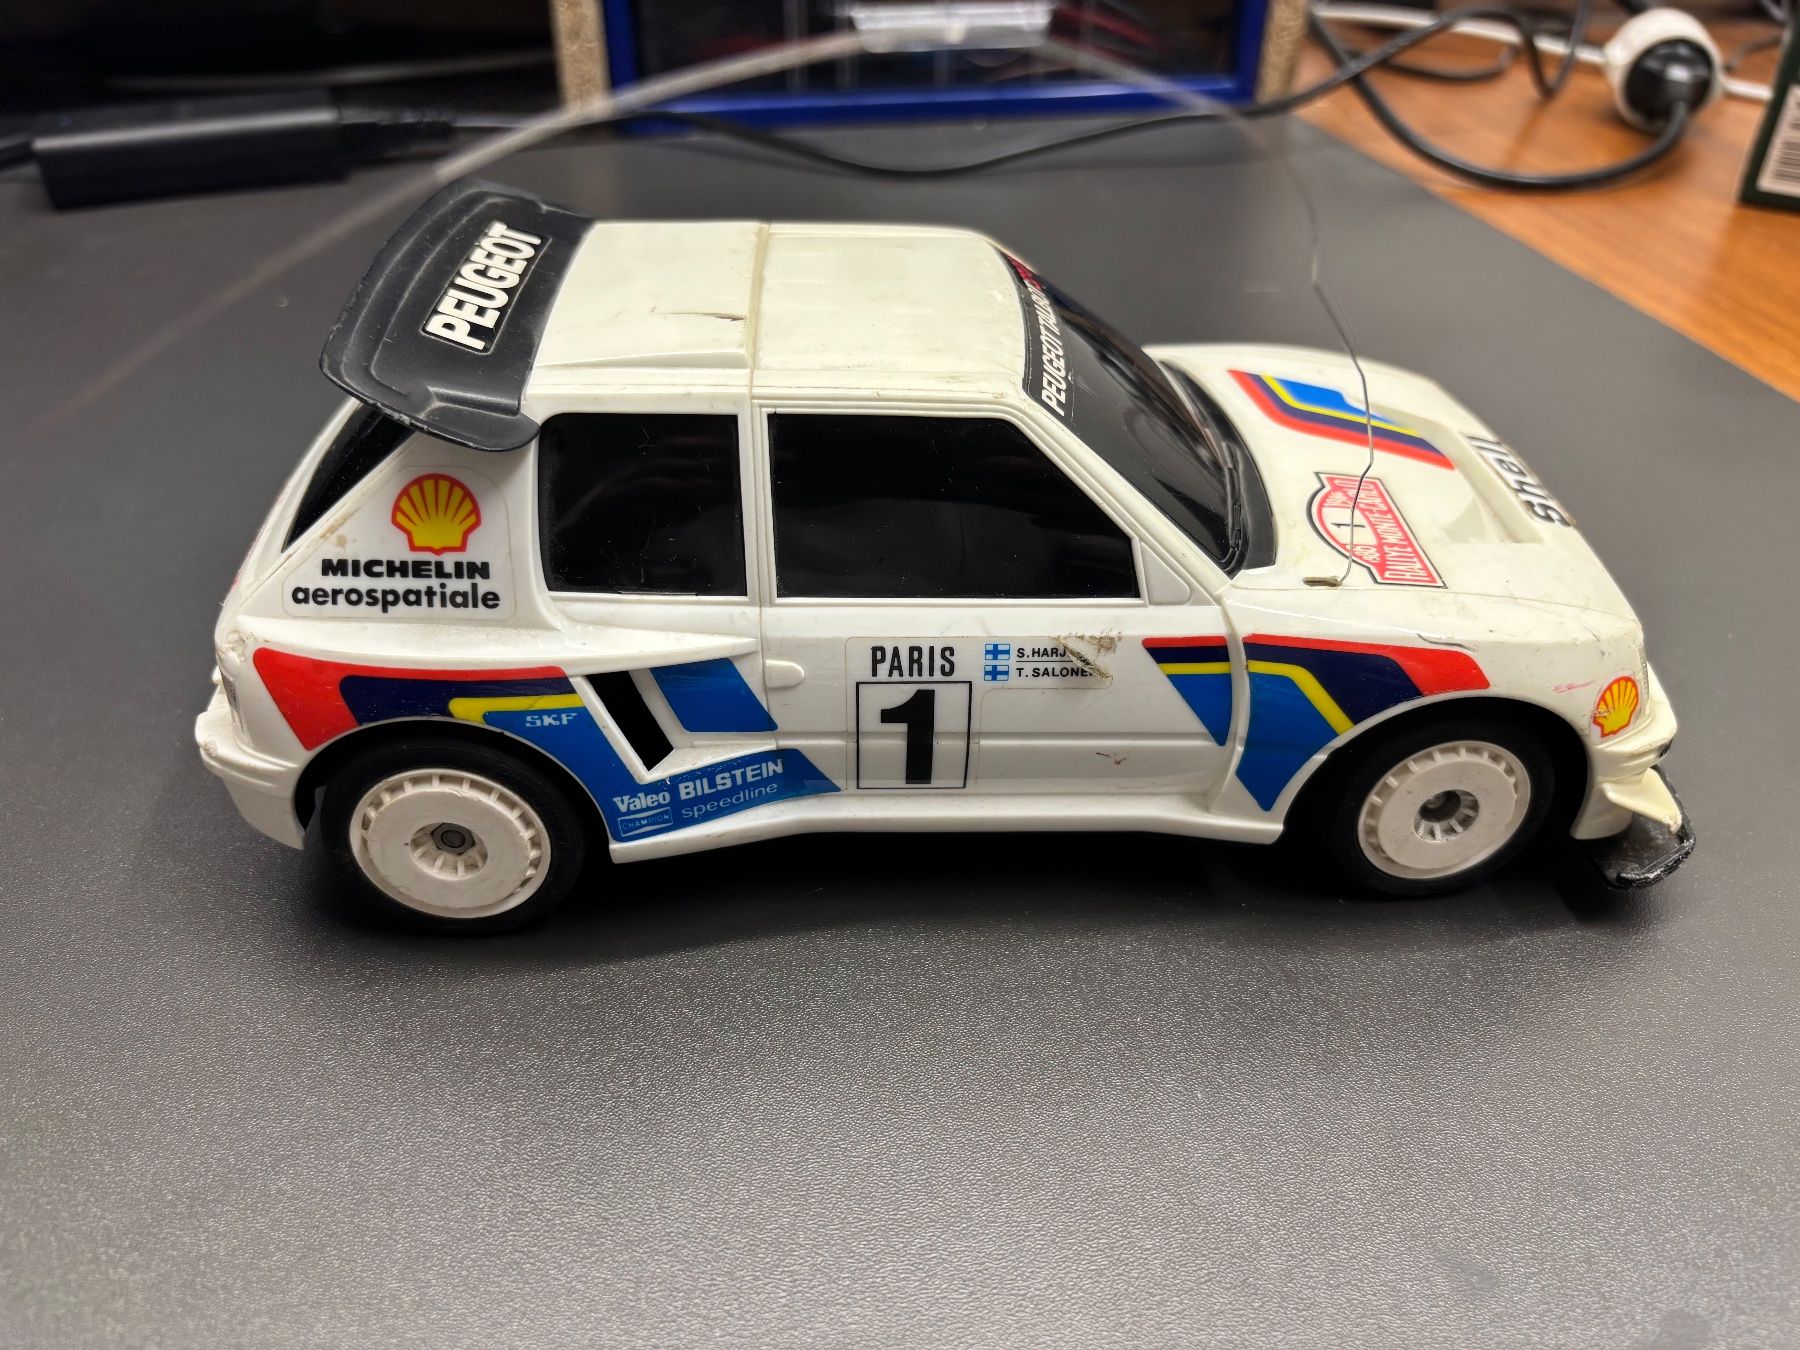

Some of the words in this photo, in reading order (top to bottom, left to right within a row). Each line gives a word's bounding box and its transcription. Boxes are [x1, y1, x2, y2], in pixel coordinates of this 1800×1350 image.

[426, 221, 542, 350] PEUGEOT
[1040, 325, 1067, 417] PEUGEOT
[1465, 435, 1572, 528] Shell
[321, 558, 490, 580] MICHELIN
[1383, 546, 1430, 579] RALLYE
[292, 582, 501, 614] aerospatiale
[870, 645, 956, 678] PARIS
[1031, 666, 1094, 678] SALONE
[525, 712, 578, 728] SKF
[880, 689, 936, 785] 1
[678, 758, 784, 801] BILSTEIN
[612, 791, 671, 813] Valeo
[681, 782, 779, 819] speedline
